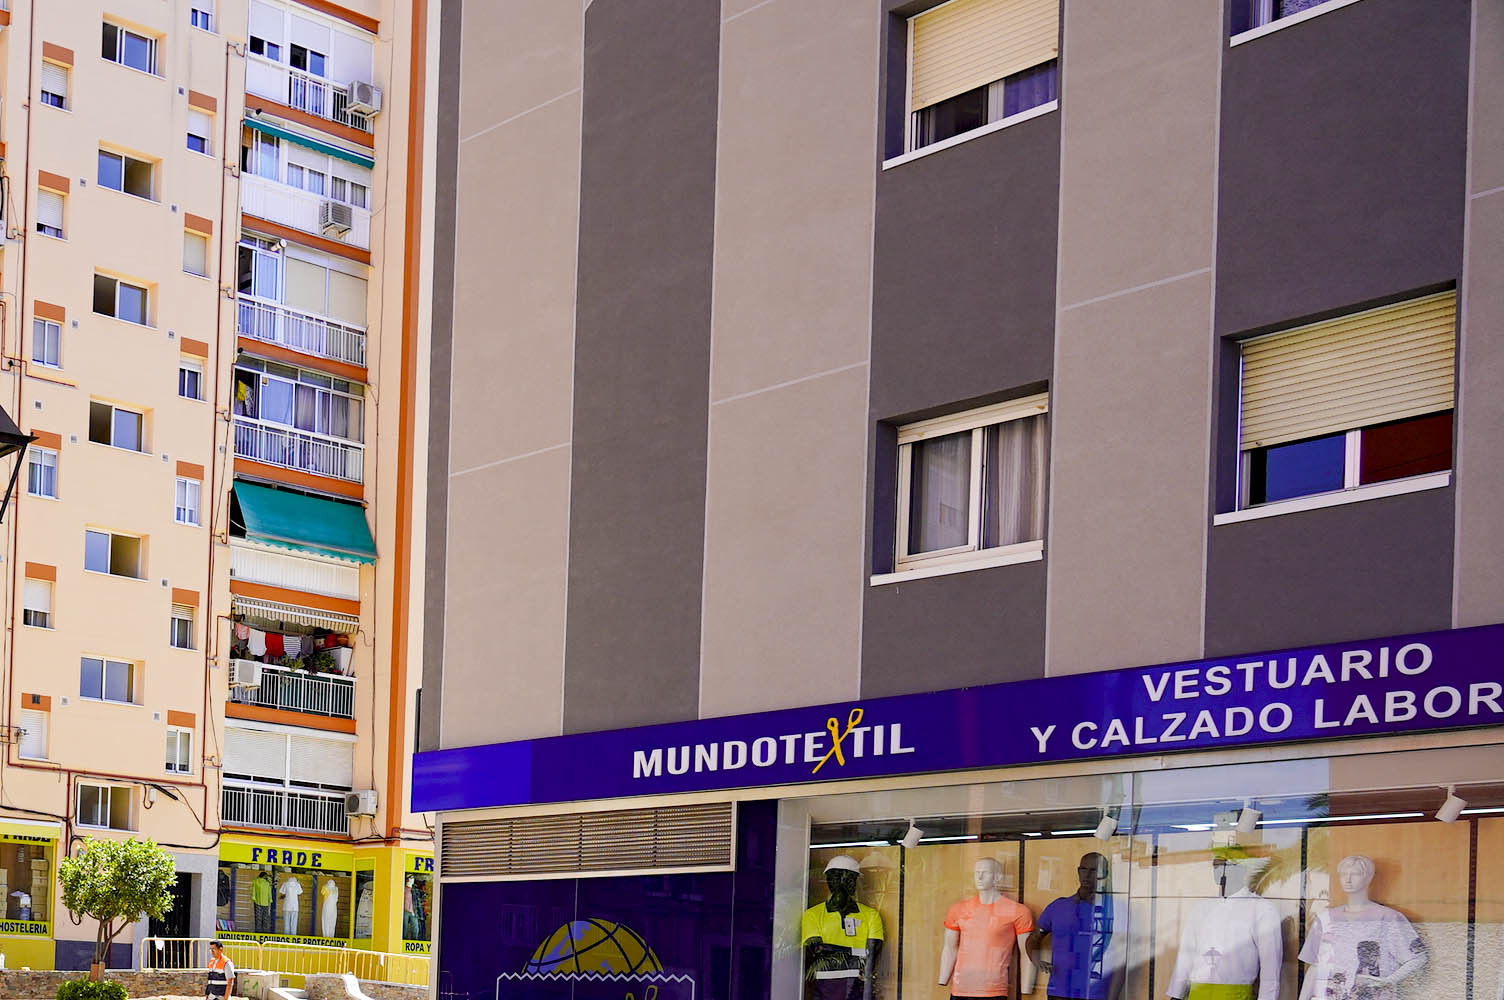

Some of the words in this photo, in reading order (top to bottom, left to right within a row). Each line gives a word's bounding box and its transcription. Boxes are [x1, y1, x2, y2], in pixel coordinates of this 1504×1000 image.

[1141, 642, 1434, 702] VESTUARIO
[632, 708, 915, 778] MUNDOTEXTIL
[1030, 725, 1057, 754] Y
[1071, 702, 1294, 750] CALZADO
[1313, 681, 1504, 730] LABOR
[252, 847, 322, 867] FRADE
[405, 942, 424, 952] ROPA
